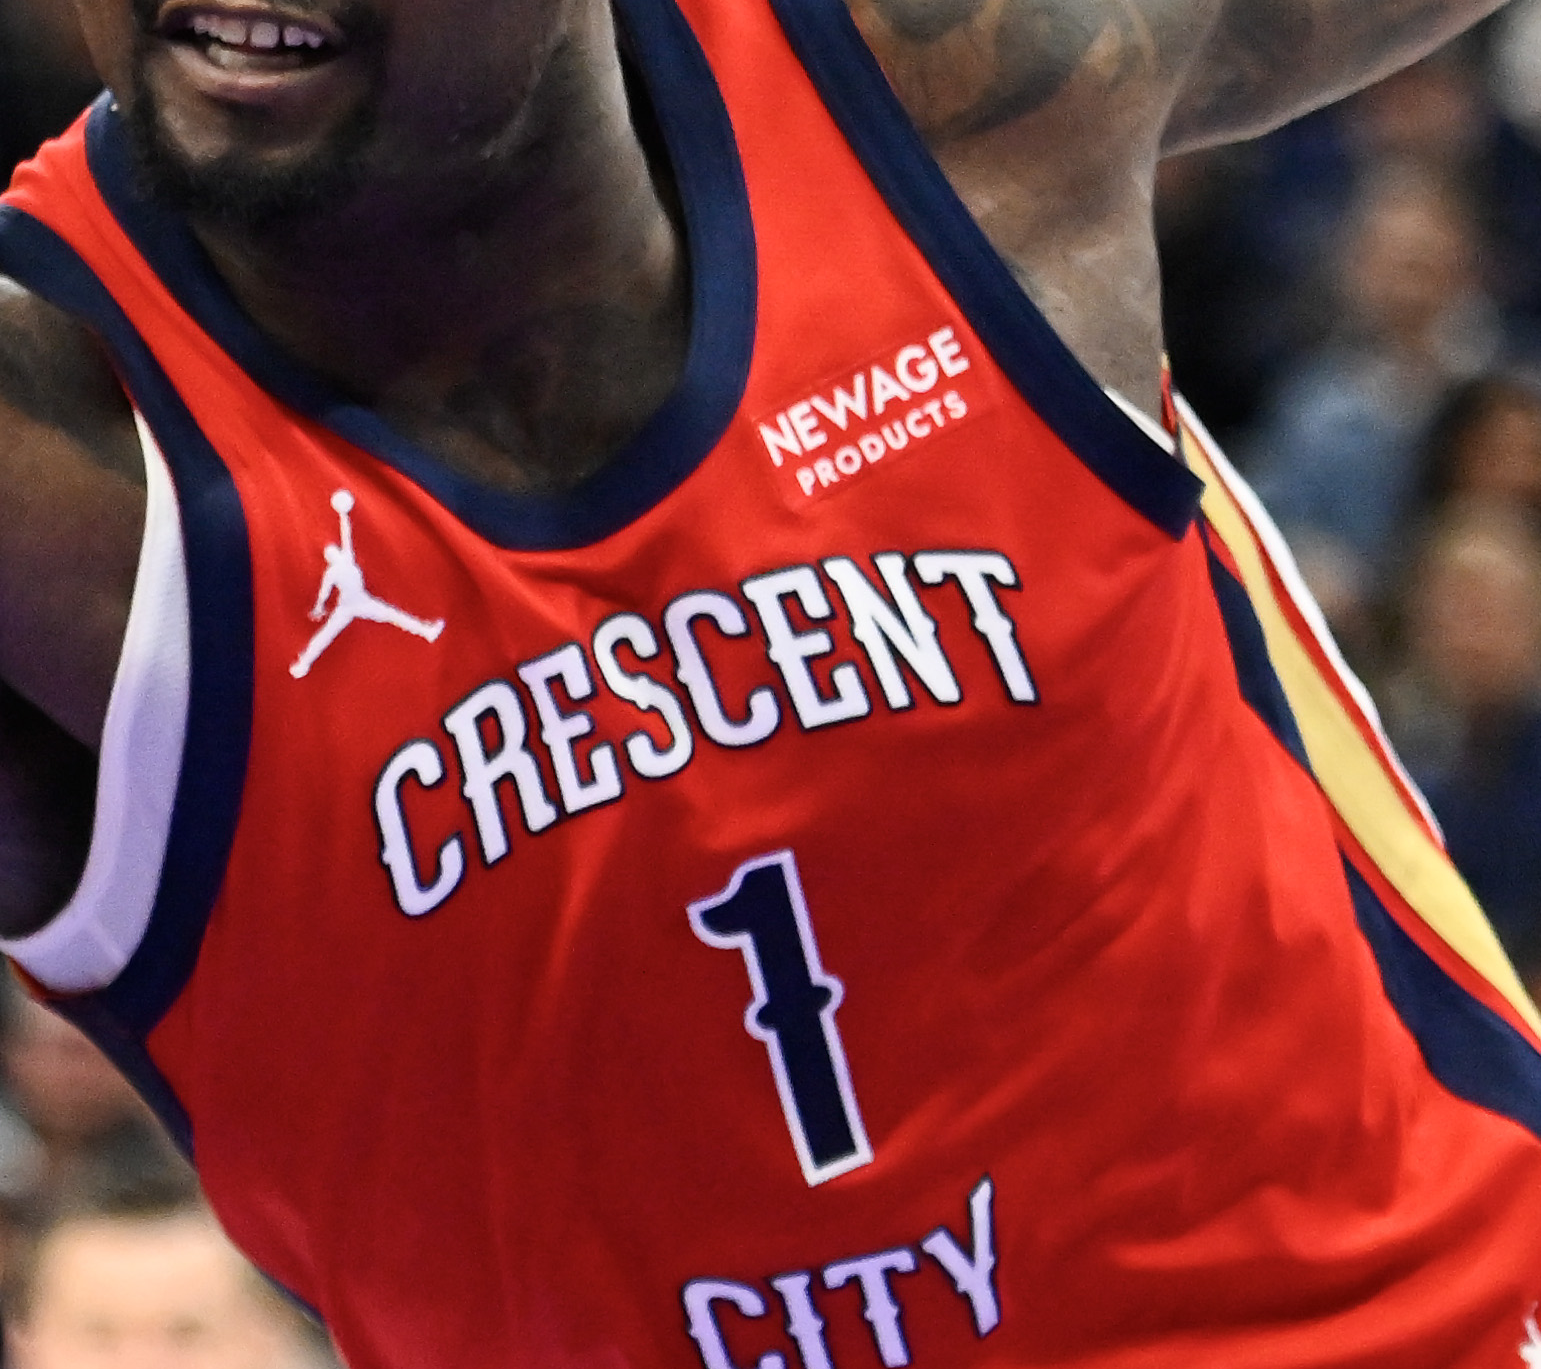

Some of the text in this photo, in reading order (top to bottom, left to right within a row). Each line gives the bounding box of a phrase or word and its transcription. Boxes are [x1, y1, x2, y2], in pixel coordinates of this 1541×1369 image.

[759, 326, 970, 468] NEWAGE
[794, 390, 969, 497] PRODUCTS
[372, 549, 1037, 918] CRESCENT
[686, 849, 874, 1188] 1
